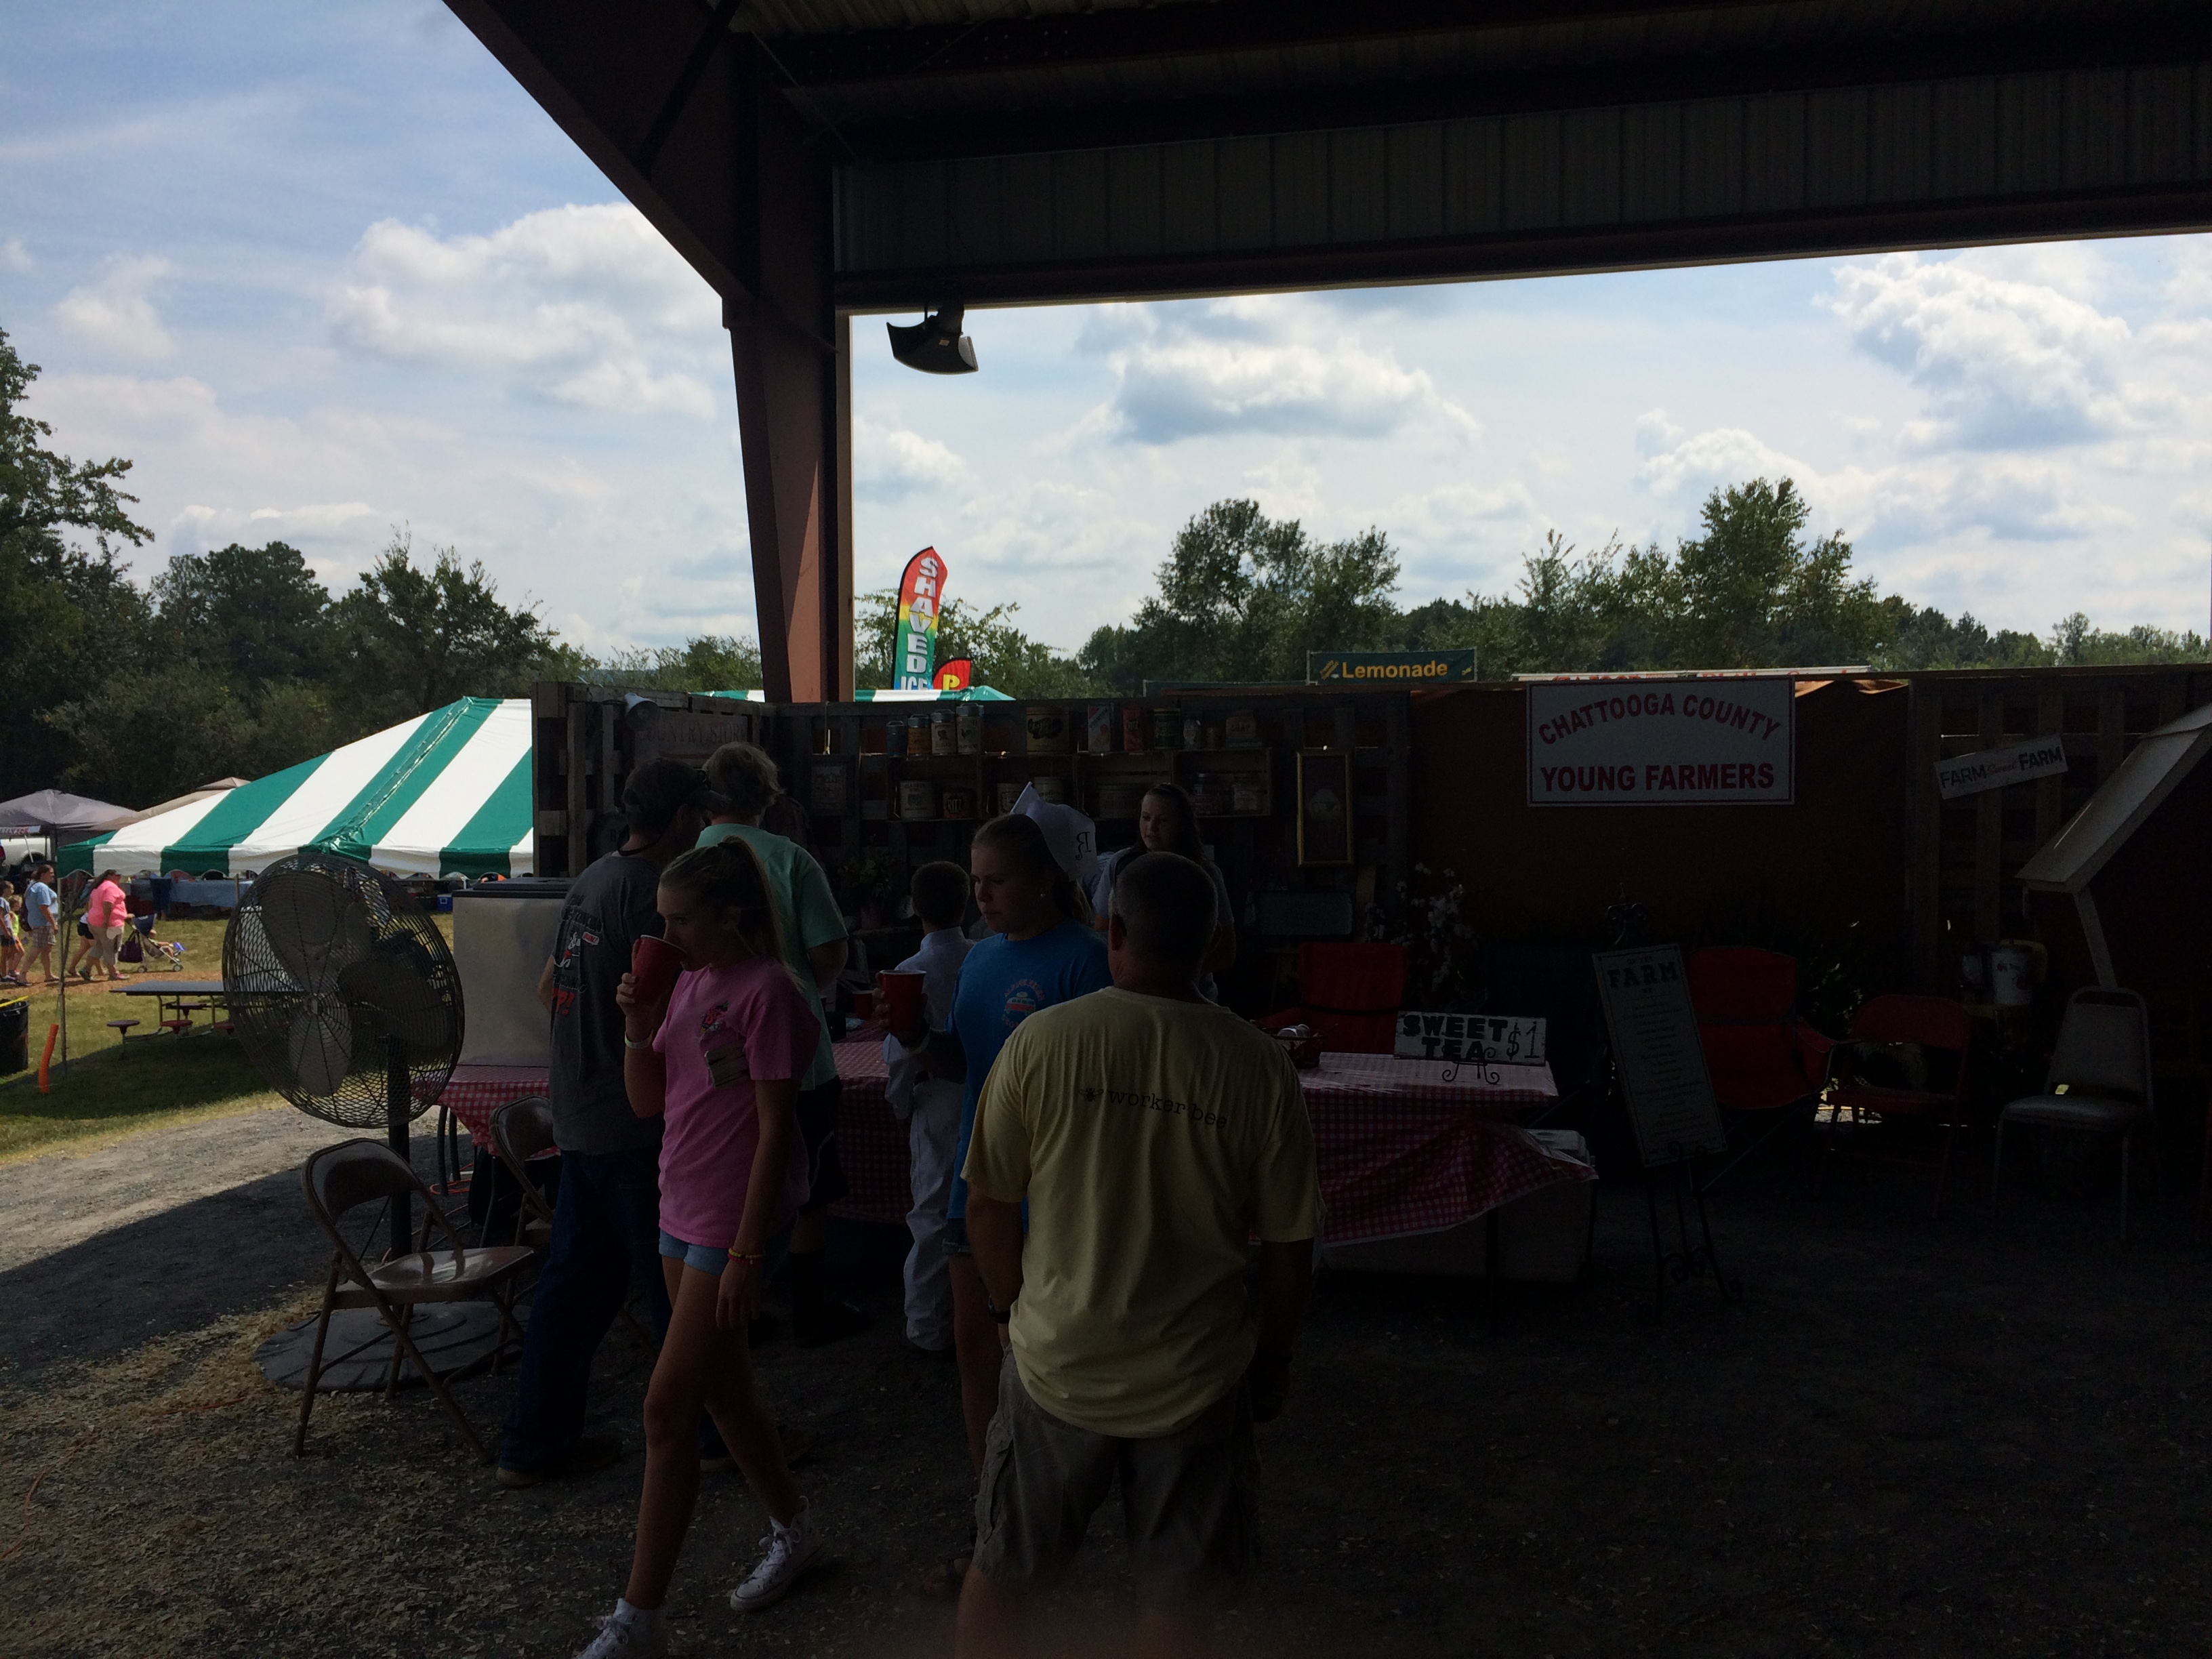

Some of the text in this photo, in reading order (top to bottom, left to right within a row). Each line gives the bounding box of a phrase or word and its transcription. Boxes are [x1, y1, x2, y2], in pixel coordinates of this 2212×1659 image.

[906, 556, 939, 674] SHAVED
[943, 674, 961, 691] P
[1341, 659, 1448, 678] Lemonade
[900, 676, 928, 691] ICE
[1538, 693, 1782, 745] CHATTOOGA COUNTY
[1540, 762, 1775, 792] YOUNG FARMERS
[1939, 763, 1988, 789] FARM
[2018, 746, 2064, 771] FARM
[1607, 960, 1679, 989] FARM
[1402, 1015, 1508, 1042] SWEET
[1506, 1021, 1540, 1061] $1
[1421, 1036, 1485, 1062] TEA
[1107, 1090, 1228, 1129] worker bee
